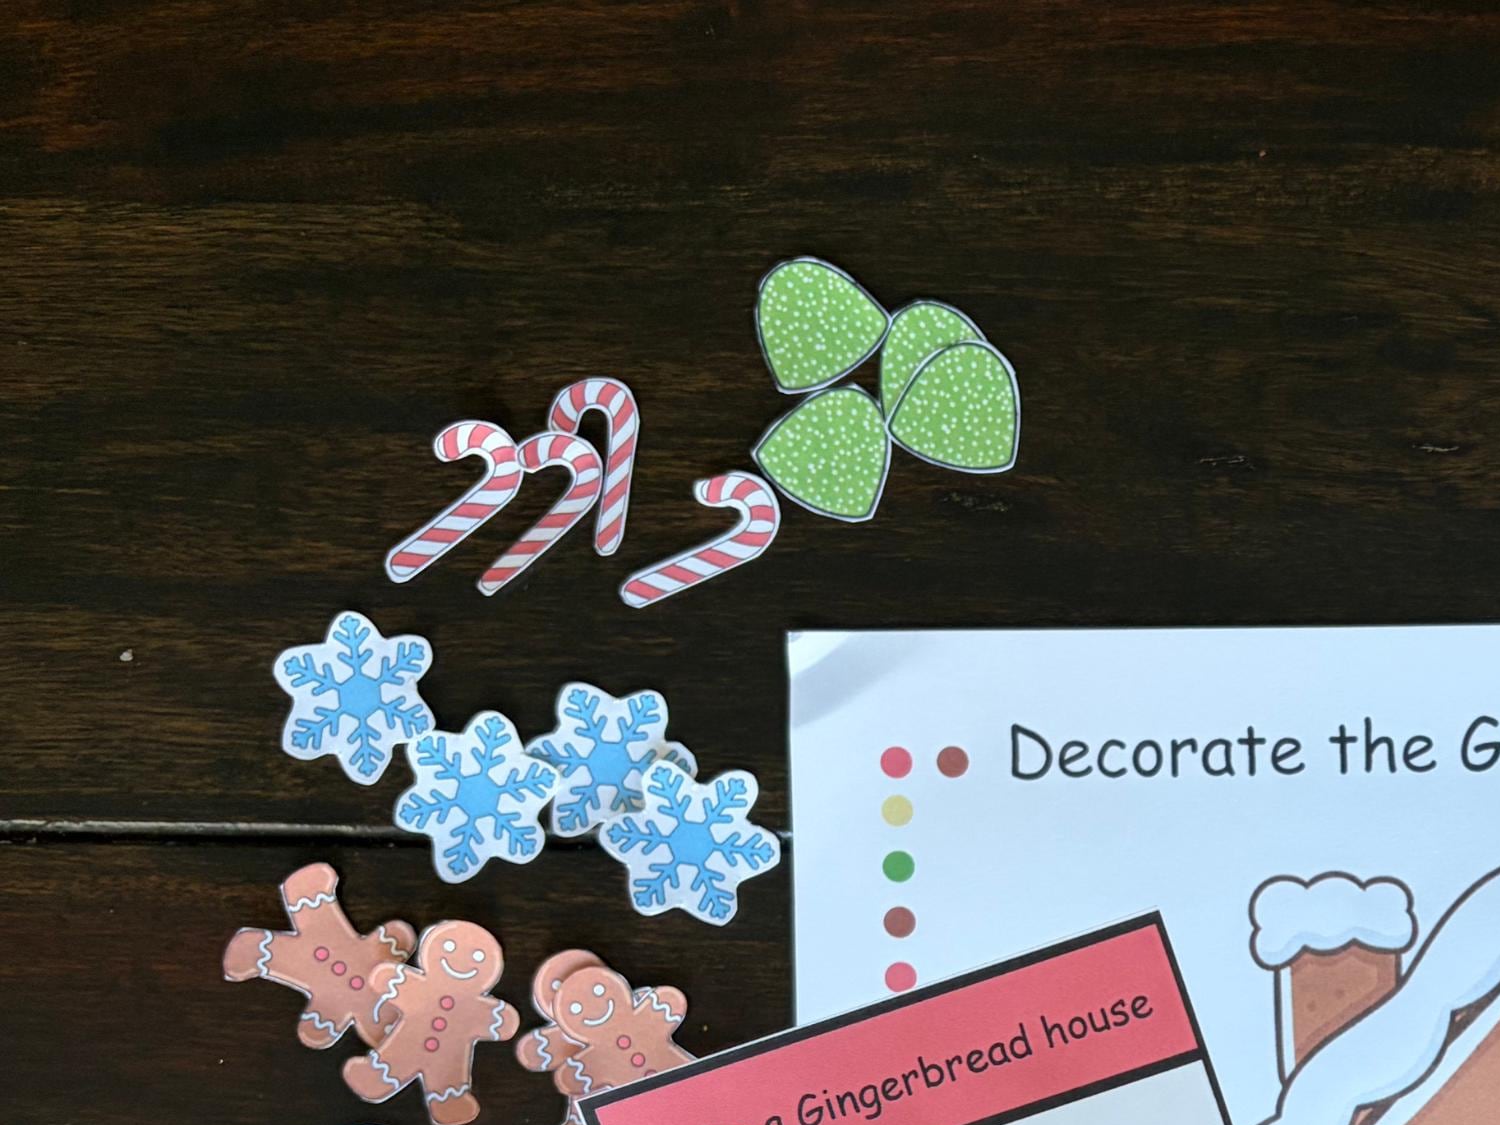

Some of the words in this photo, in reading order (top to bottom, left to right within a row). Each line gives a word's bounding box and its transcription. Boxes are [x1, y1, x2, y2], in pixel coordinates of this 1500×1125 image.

[1011, 724, 1305, 780] Decorate
[1329, 717, 1436, 774] the
[1040, 996, 1153, 1048] house
